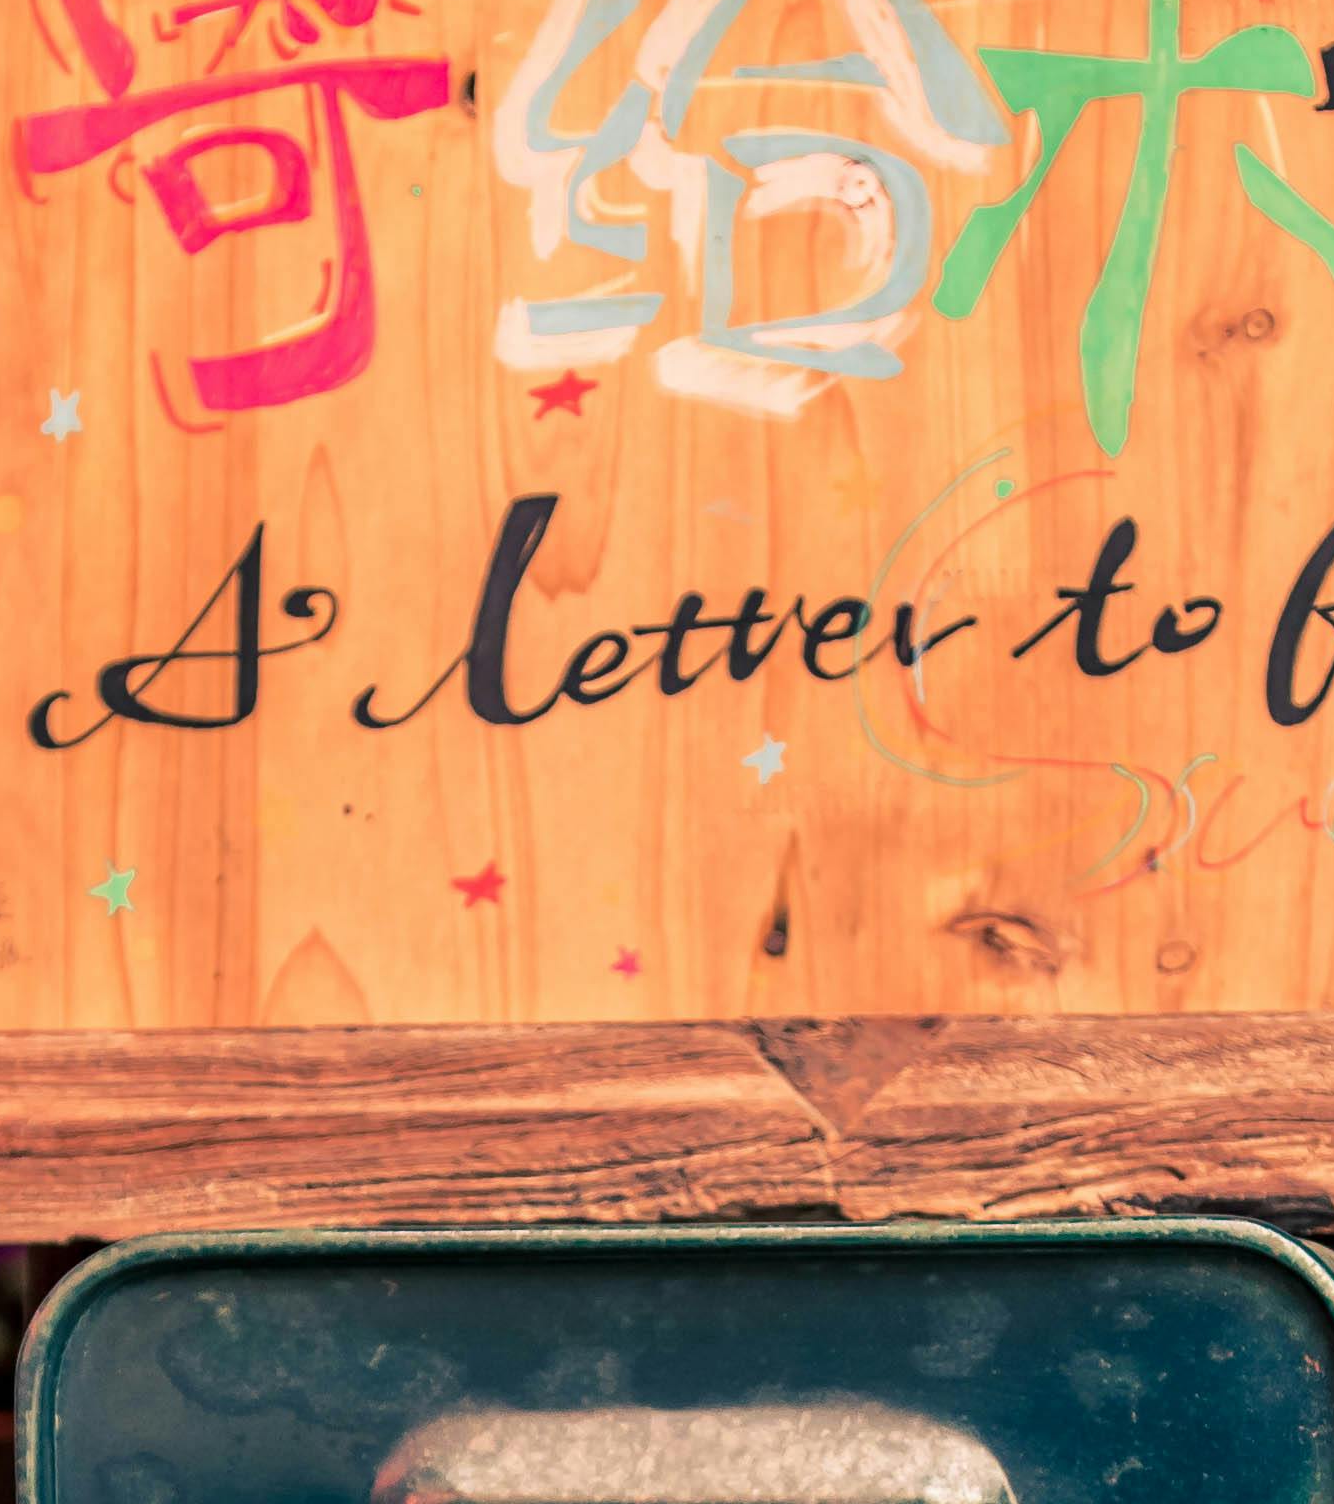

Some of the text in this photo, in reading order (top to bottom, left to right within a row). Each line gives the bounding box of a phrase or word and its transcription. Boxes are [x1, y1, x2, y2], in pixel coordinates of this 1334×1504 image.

[29, 521, 337, 748] A
[353, 493, 977, 732] letter
[1014, 518, 1222, 677] to
